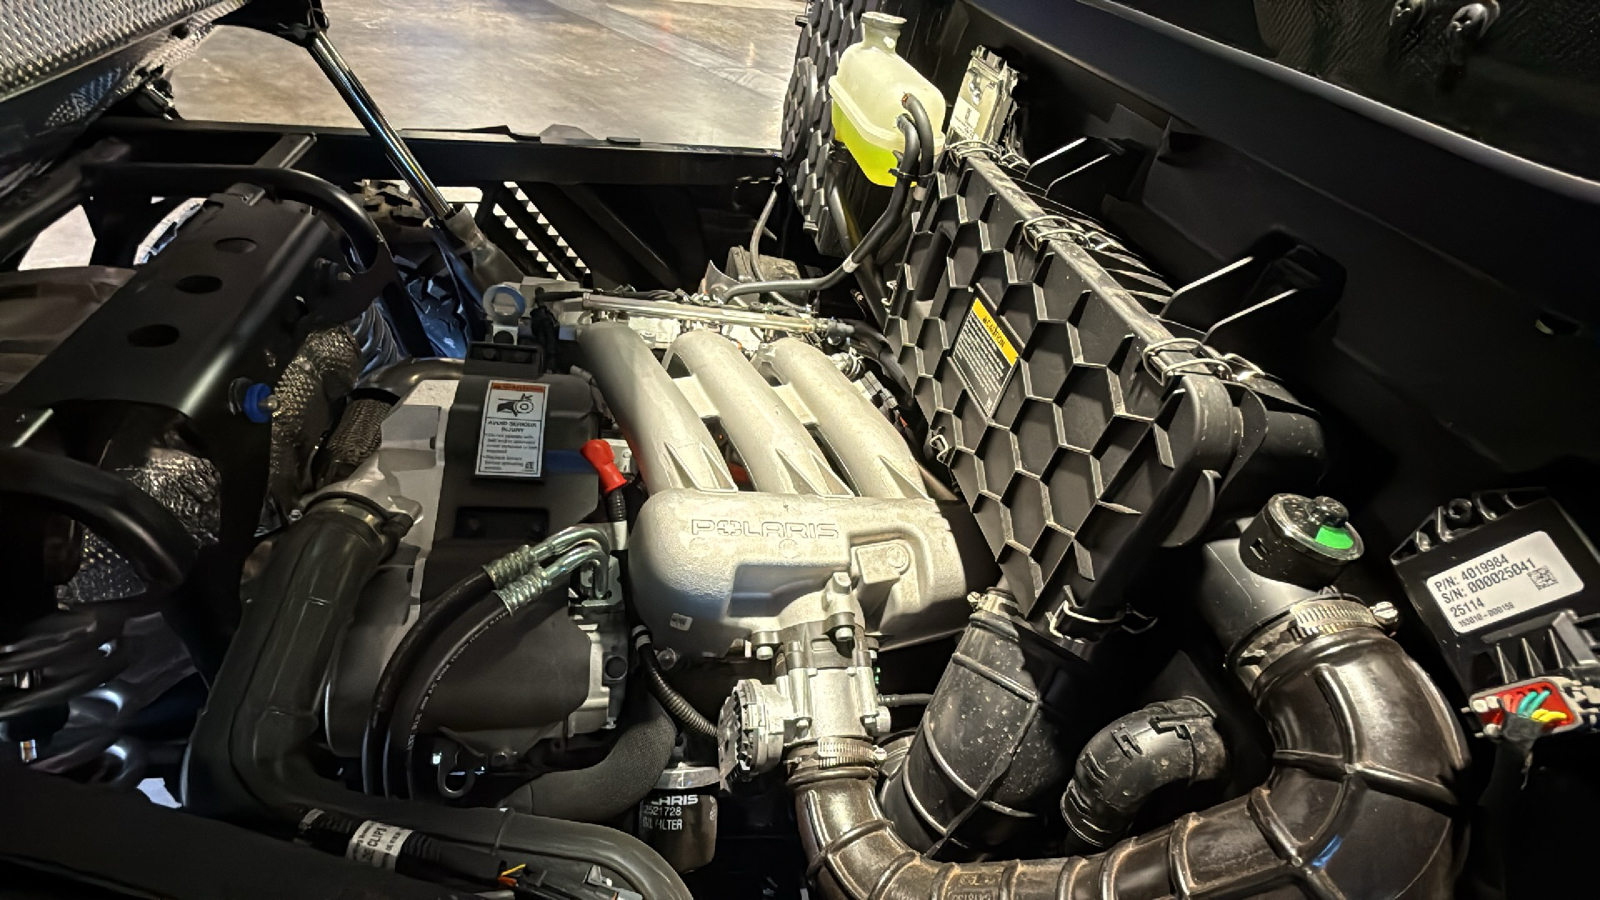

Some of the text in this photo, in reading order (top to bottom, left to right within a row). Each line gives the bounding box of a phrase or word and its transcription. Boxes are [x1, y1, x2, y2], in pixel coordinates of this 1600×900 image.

[691, 519, 839, 539] POLARIS
[1434, 553, 1509, 592] P/N: 4019984
[1441, 557, 1536, 604] S/N: 000025041
[1450, 597, 1485, 618] 25114
